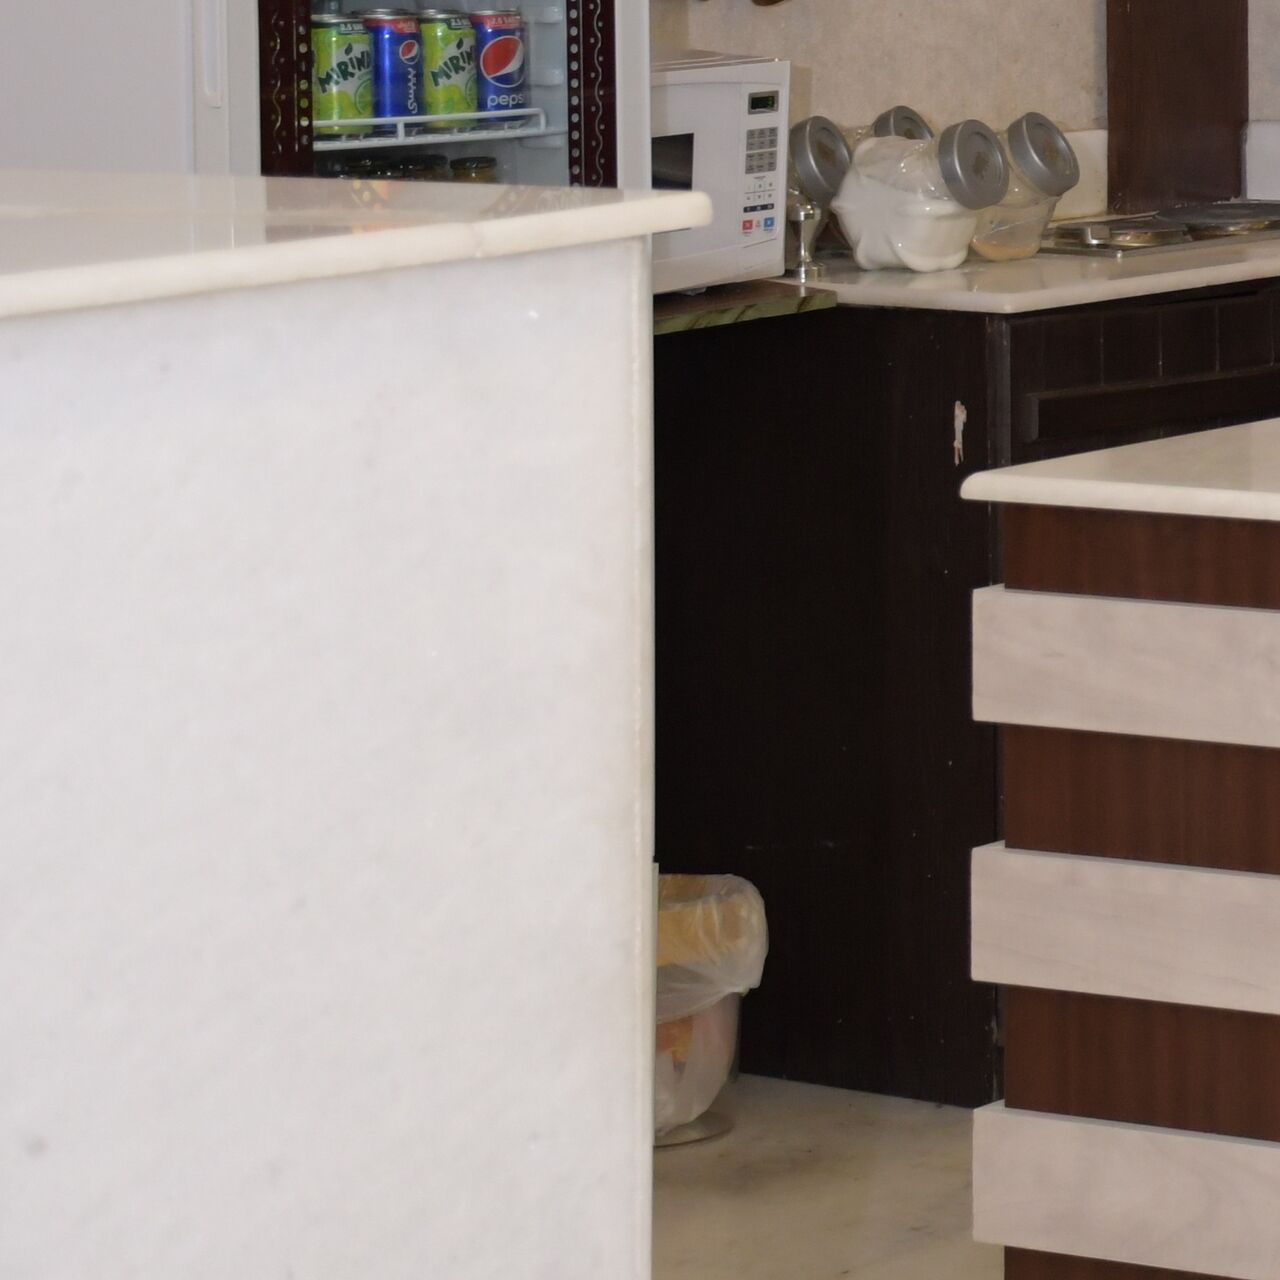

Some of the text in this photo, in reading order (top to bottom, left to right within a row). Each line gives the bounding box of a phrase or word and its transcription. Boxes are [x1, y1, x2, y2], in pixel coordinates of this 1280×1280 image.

[318, 50, 371, 94] MIRIN
[430, 45, 477, 88] MIRIN
[487, 93, 525, 110] peps
